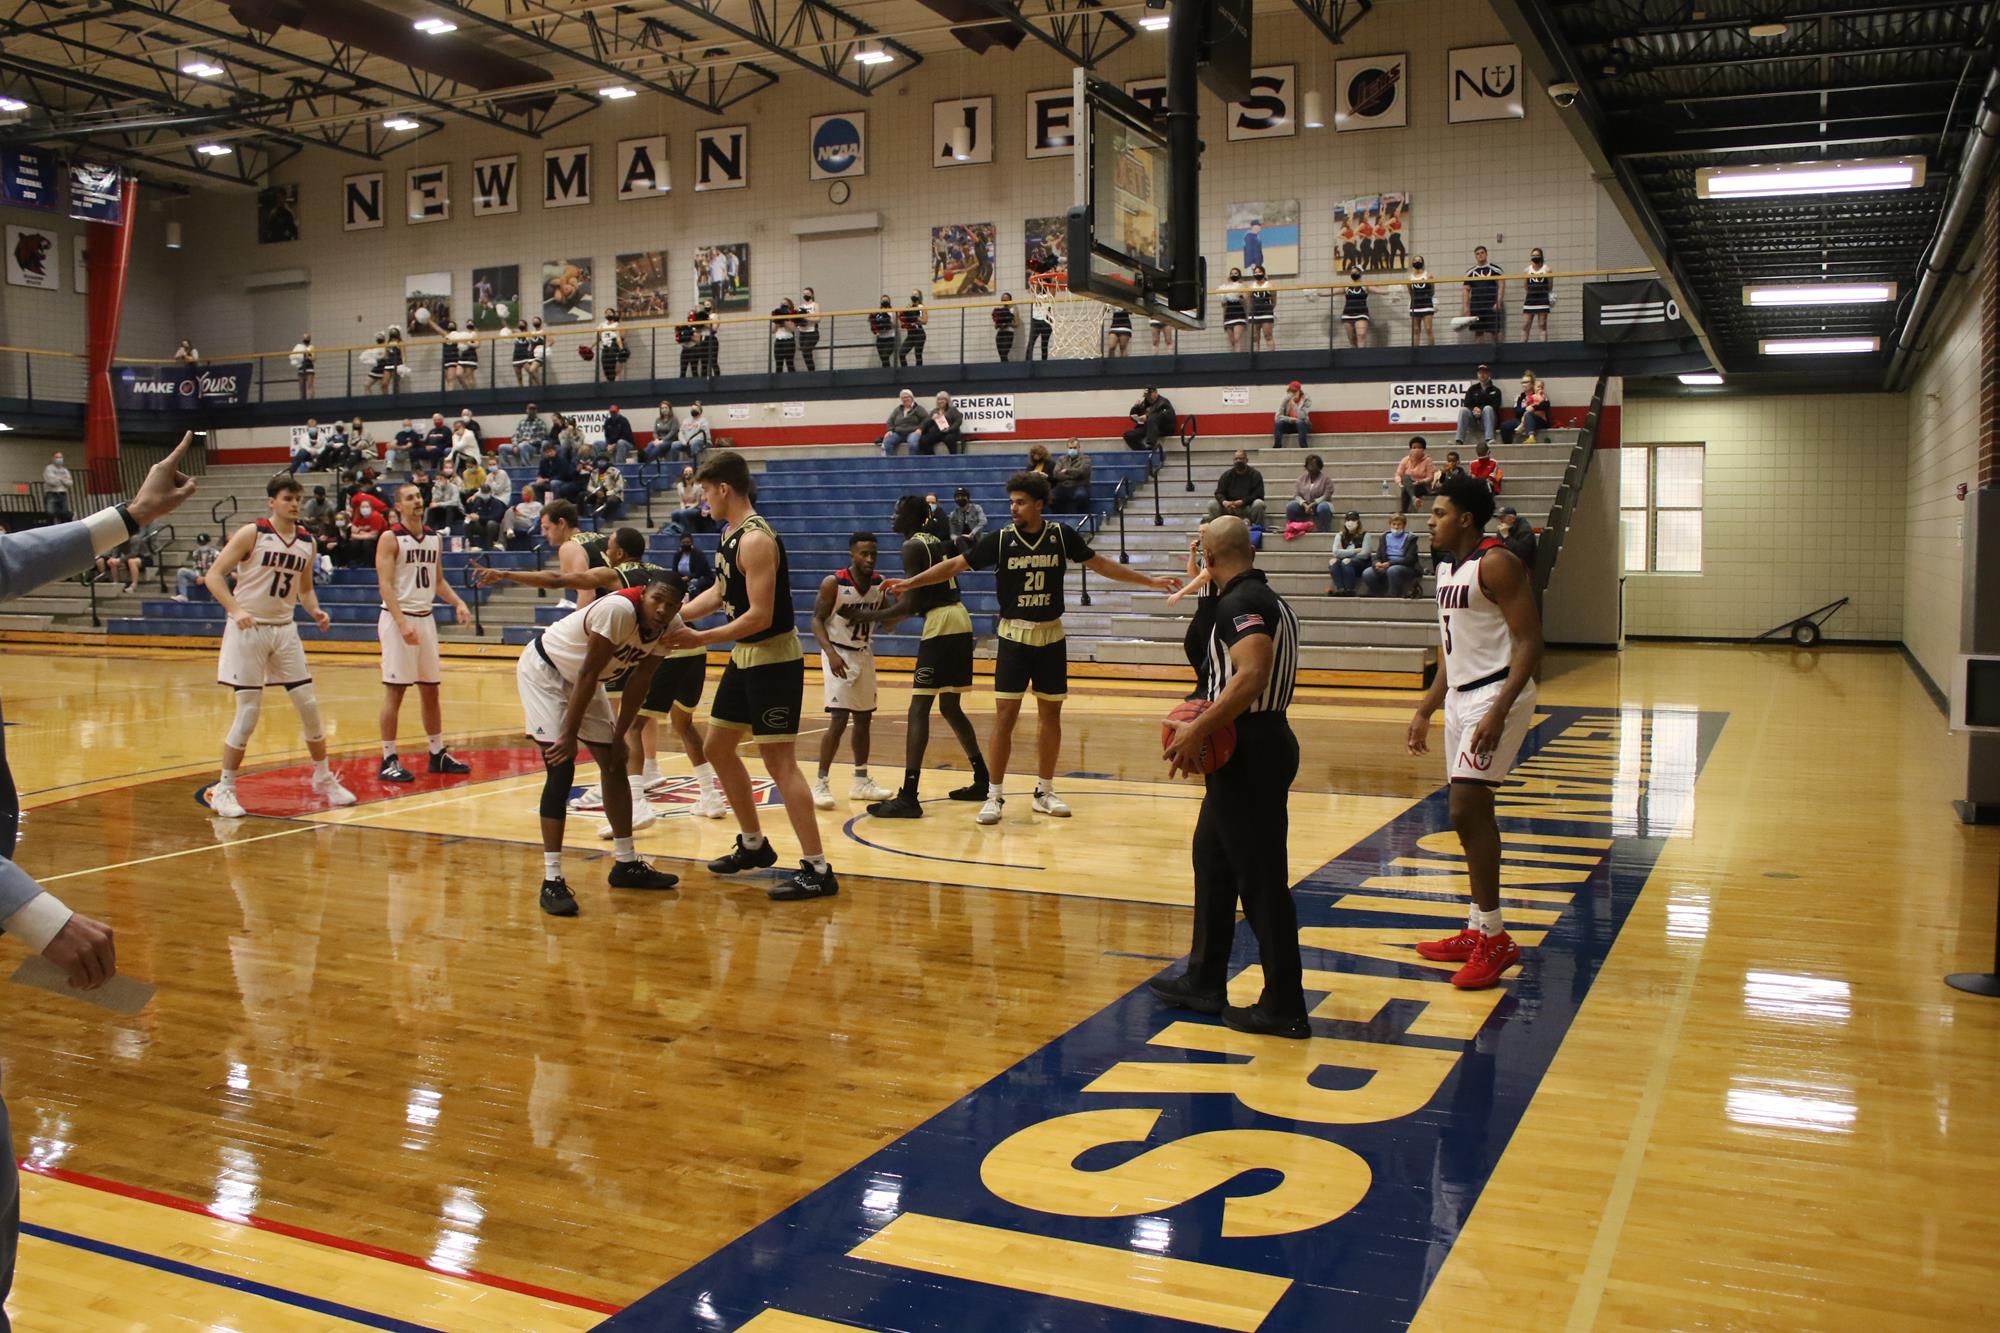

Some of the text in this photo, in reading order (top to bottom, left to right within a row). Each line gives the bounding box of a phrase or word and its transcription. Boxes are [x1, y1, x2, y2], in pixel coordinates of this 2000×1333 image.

[1455, 65, 1515, 101] NU
[817, 143, 860, 161] NCAA
[133, 382, 175, 393] MAKE
[1394, 383, 1468, 395] GENERAL
[951, 397, 1011, 408] GENERAL
[961, 410, 1013, 420] MISSION
[292, 426, 331, 436] STUNT
[1007, 554, 1059, 570] EMPORIA
[269, 571, 294, 598] 13
[416, 566, 430, 589] 10
[1024, 571, 1045, 592] 20
[1017, 593, 1051, 608] STATE
[1443, 615, 1452, 655] 3
[733, 830, 1614, 1333] UNIVERSI
